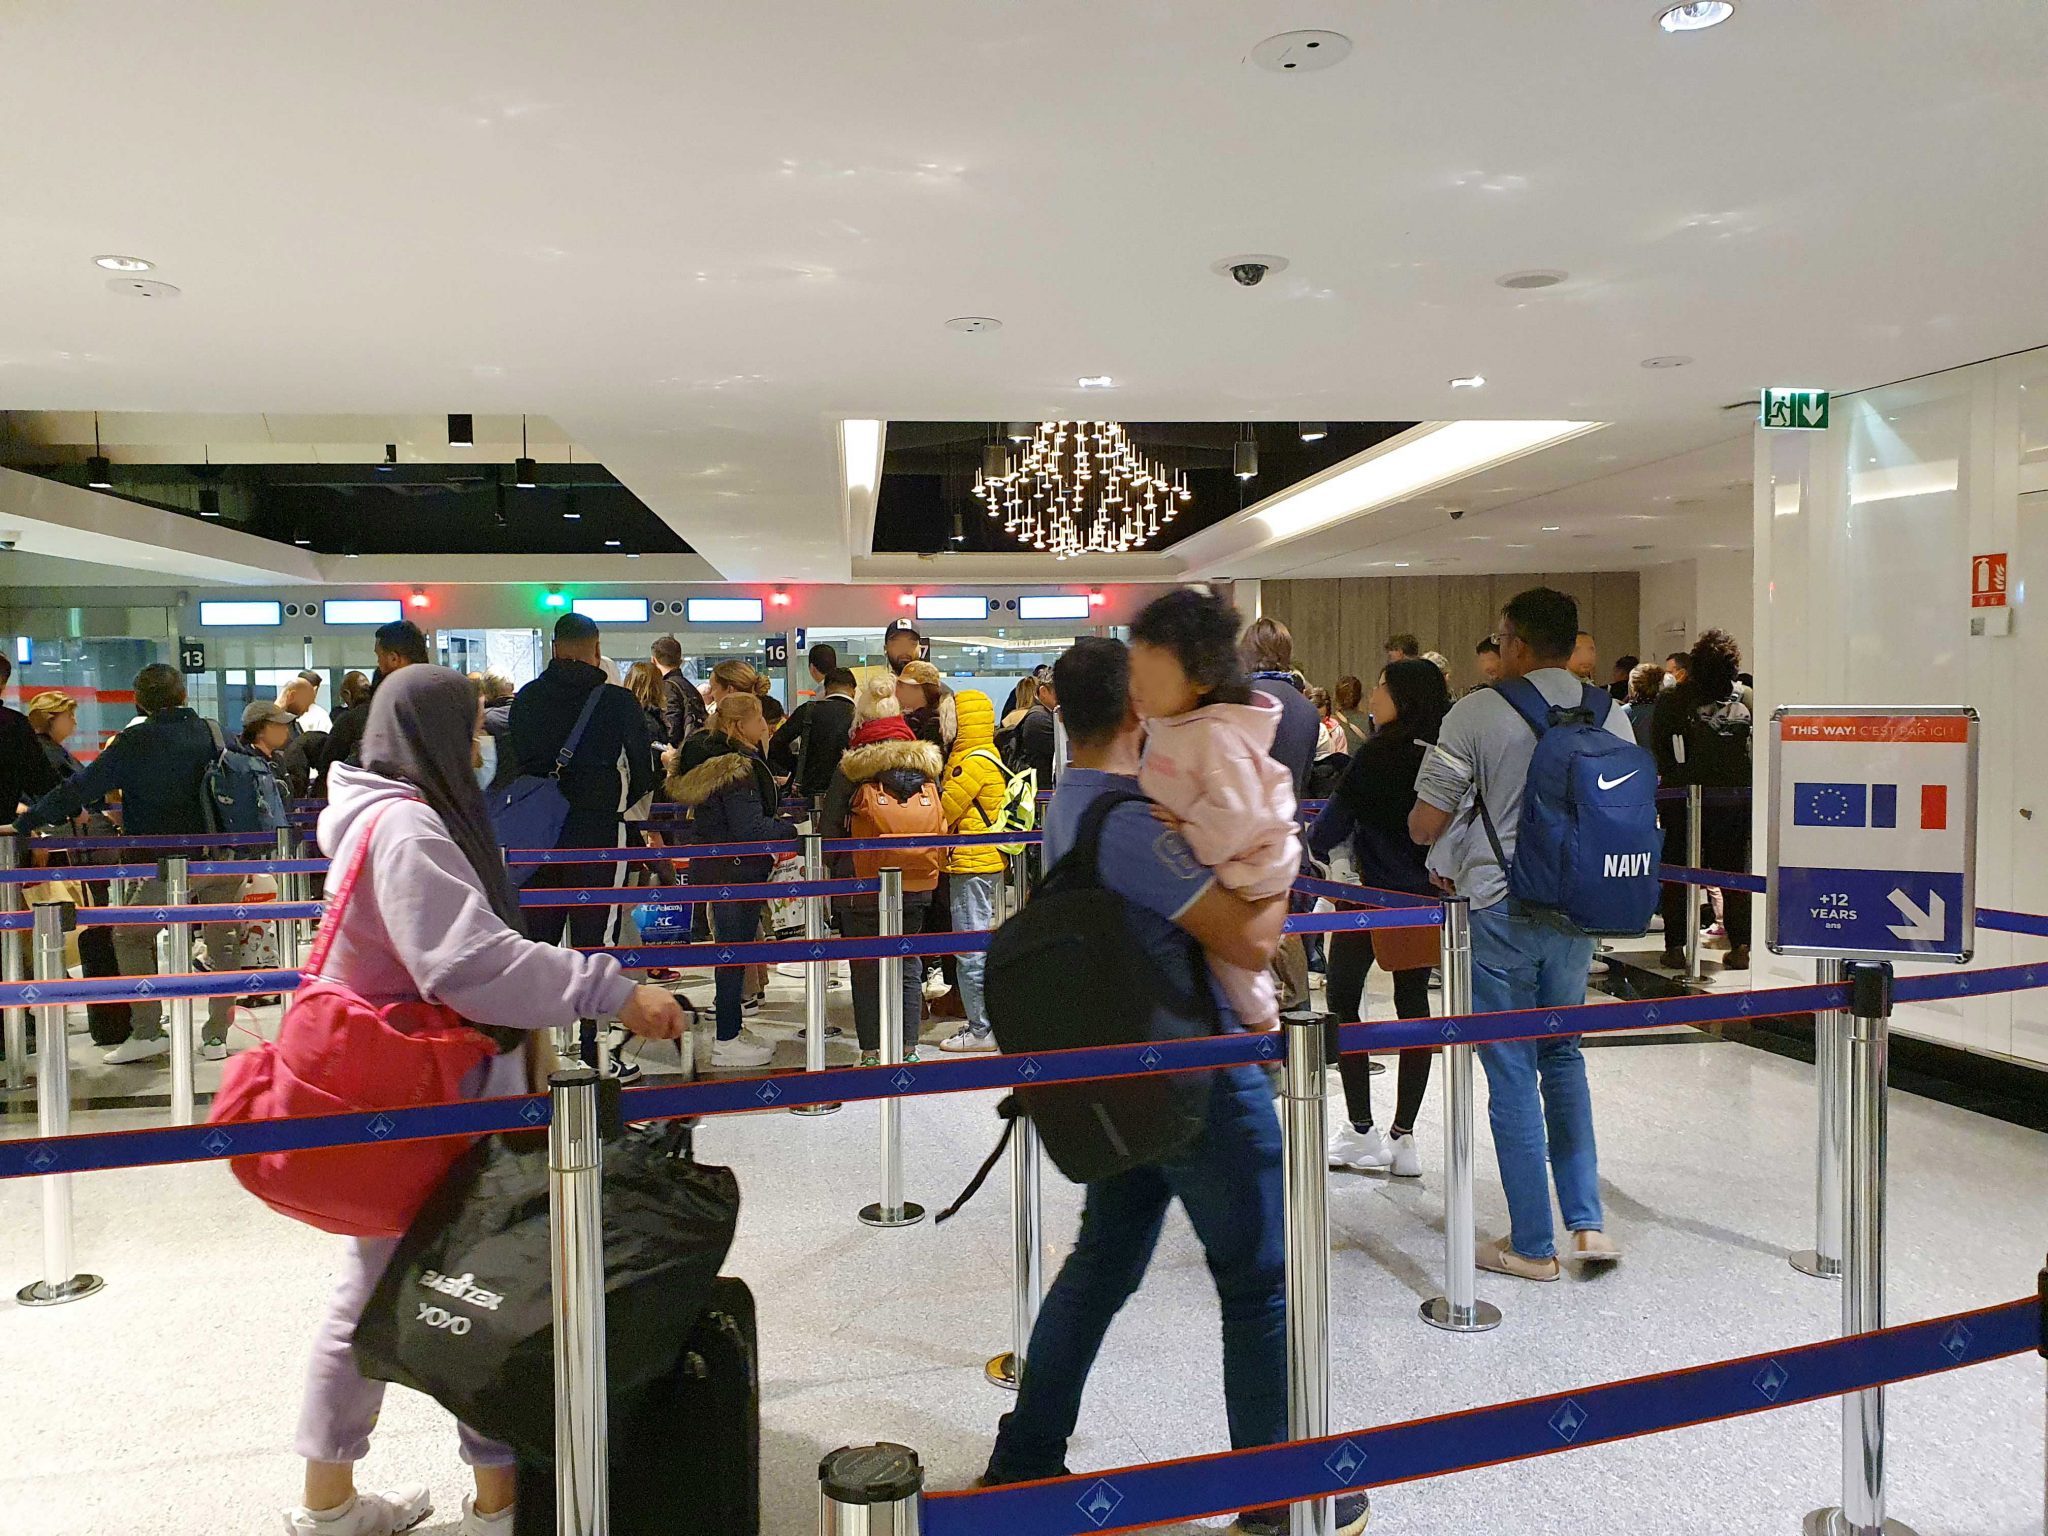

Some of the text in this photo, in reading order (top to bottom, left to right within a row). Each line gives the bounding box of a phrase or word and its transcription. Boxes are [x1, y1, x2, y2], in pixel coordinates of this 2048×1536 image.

[182, 650, 203, 666] 13
[766, 645, 786, 660] 16
[1790, 725, 1819, 735] THIS
[1823, 726, 1856, 736] WAY!
[1860, 726, 1896, 736] C'EST
[1900, 727, 1926, 736] PAR
[1603, 851, 1651, 878] NAVY
[1820, 893, 1849, 906] +12
[1810, 908, 1858, 920] YEARS
[416, 1302, 472, 1335] YOYO
